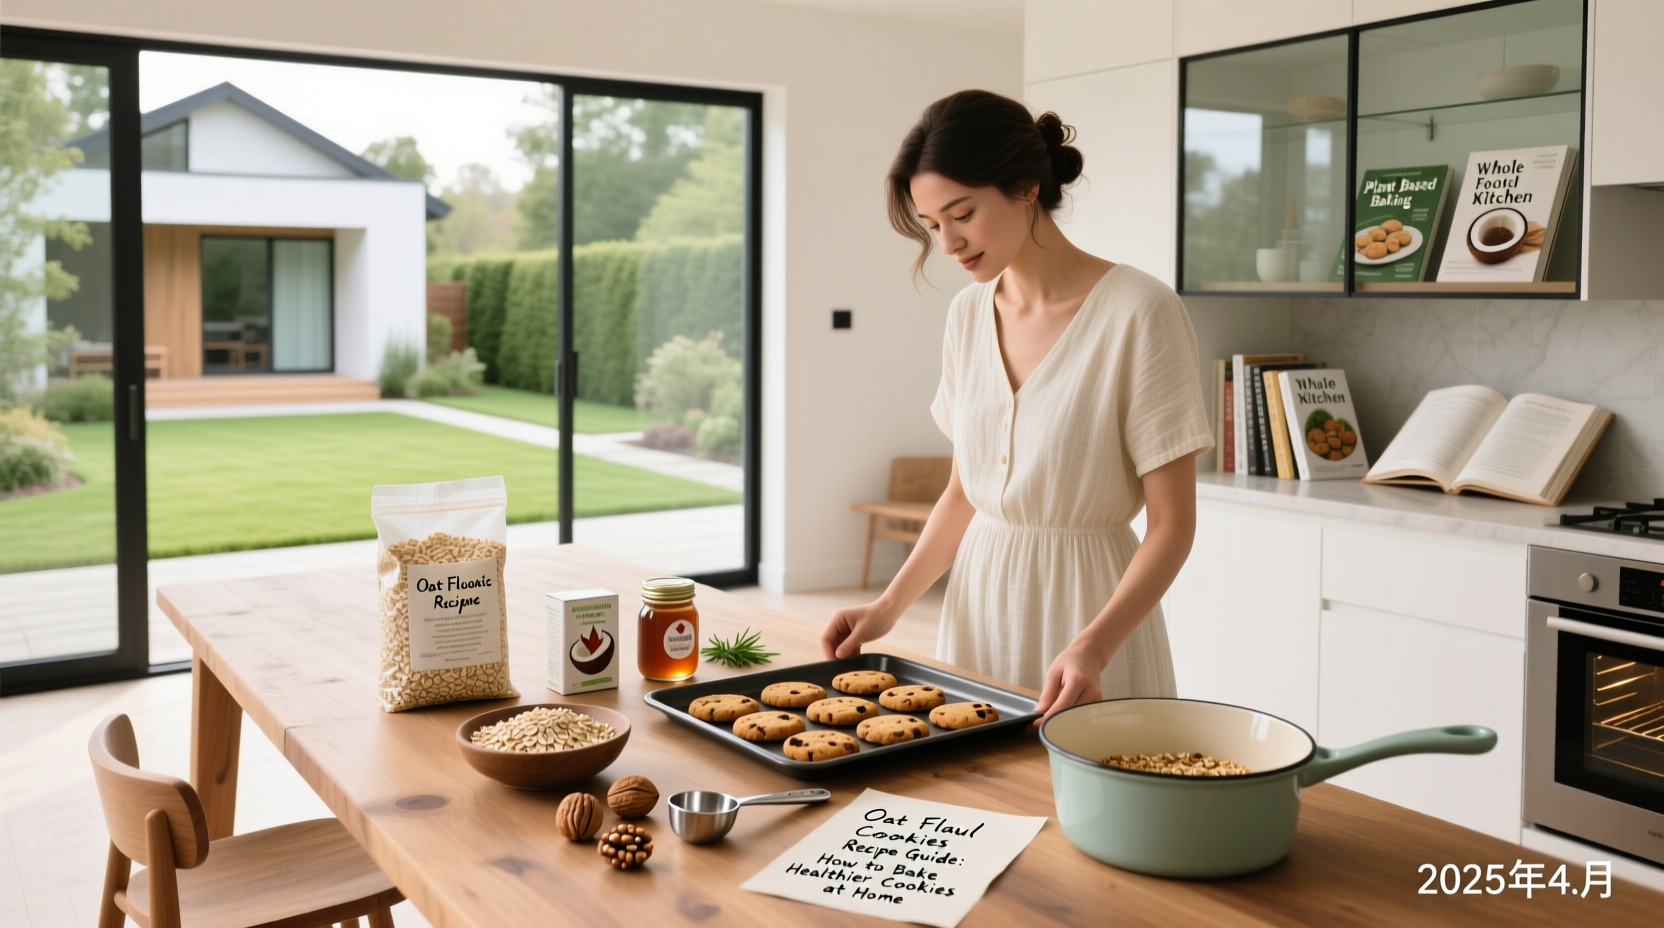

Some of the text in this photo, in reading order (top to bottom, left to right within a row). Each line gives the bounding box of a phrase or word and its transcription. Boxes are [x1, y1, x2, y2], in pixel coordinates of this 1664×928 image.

[1477, 159, 1524, 175] Whole
[1472, 189, 1532, 204] Kitchen
[1298, 391, 1345, 404] Kitchen
[417, 578, 443, 592] Oat
[864, 808, 908, 825] Oat
[856, 826, 949, 847] Cookies
[842, 839, 964, 866] Recipe Guide:
[816, 852, 938, 880] How to Bake
[785, 862, 956, 896] Healthier Cookies
[823, 884, 904, 904] at Home
